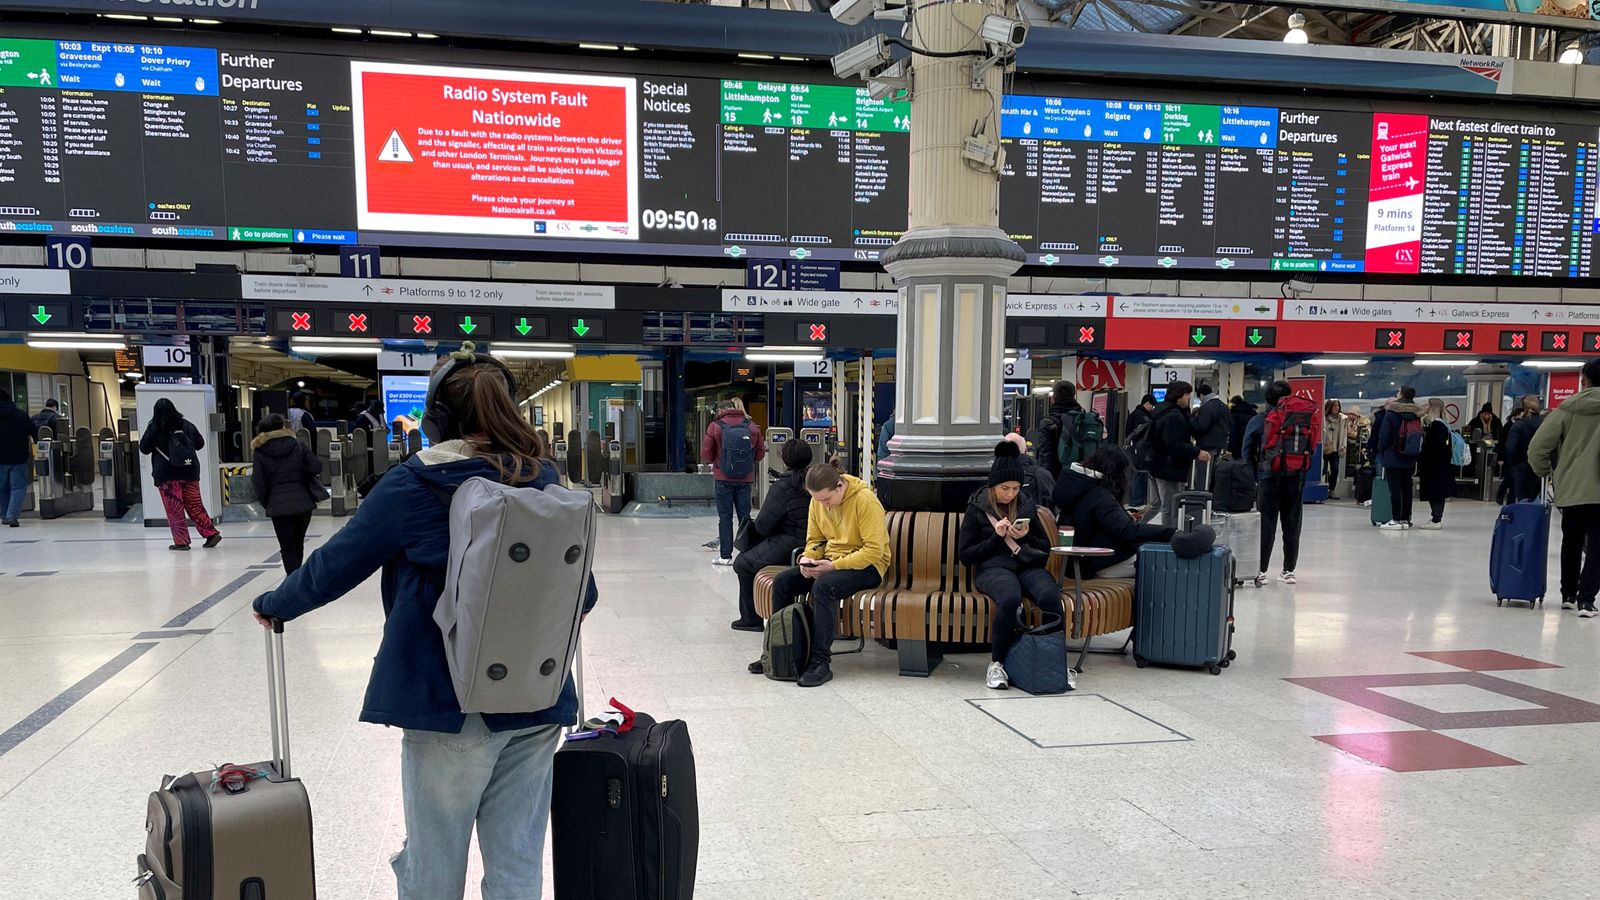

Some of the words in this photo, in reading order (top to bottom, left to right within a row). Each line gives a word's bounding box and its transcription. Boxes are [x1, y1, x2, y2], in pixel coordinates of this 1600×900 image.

[91, 44, 111, 53] Expt
[113, 45, 134, 53] 10:05
[141, 47, 162, 55] 10:10
[60, 53, 102, 61] Gravesend
[141, 57, 164, 65] Dover
[167, 58, 190, 68] Priory
[221, 53, 275, 69] Further
[142, 79, 161, 87] Wait
[222, 74, 303, 91] Departures
[724, 82, 743, 90] 09:46
[758, 83, 787, 93] Delayed
[643, 81, 688, 98] Special
[790, 85, 809, 93] 09:54
[443, 85, 487, 101] Radio
[492, 88, 547, 106] System
[551, 92, 588, 107] Fault
[724, 93, 780, 104] Littlehampton
[791, 94, 803, 102] Ore
[856, 97, 884, 106] Brighton
[643, 98, 691, 113] Notices
[1045, 98, 1062, 106] 10:06
[1129, 103, 1143, 112] Expt
[1044, 107, 1059, 115] West
[472, 110, 561, 128] Nationwide
[724, 113, 736, 122] 15
[791, 116, 803, 125] 18
[1105, 112, 1131, 122] Reigate
[1164, 113, 1188, 122] Dorking
[1223, 118, 1271, 127] Littlehampton
[1280, 112, 1320, 125] Further
[856, 119, 868, 128] 14
[1430, 119, 1454, 131] Next
[1455, 120, 1489, 132] fastest
[1491, 122, 1519, 134] direct
[1520, 124, 1544, 136] train
[1545, 126, 1556, 136] to
[452, 129, 468, 137] fault
[470, 130, 487, 138] with
[489, 131, 501, 139] the
[503, 132, 522, 140] radio
[524, 134, 552, 143] systems
[554, 135, 585, 143] between
[587, 136, 599, 144] the
[601, 137, 622, 145] driver
[1164, 133, 1174, 142] 11
[1279, 130, 1338, 144] Departures
[434, 139, 446, 147] the
[448, 140, 481, 149] signaller,
[483, 142, 515, 151] affecting
[527, 144, 544, 152] train
[546, 145, 574, 153] services
[576, 146, 593, 154] from
[595, 147, 623, 156] Victoria
[1380, 144, 1398, 153] Your
[1400, 140, 1417, 150] next
[437, 150, 458, 158] other
[459, 151, 487, 159] London
[489, 152, 526, 161] Terminals.
[530, 155, 562, 164] Journeys
[563, 157, 578, 165] may
[580, 157, 596, 165] take
[597, 158, 620, 167] longer
[1381, 150, 1412, 162] Gatwick
[452, 162, 474, 170] usual,
[492, 164, 521, 172] services
[548, 166, 574, 175] subject
[585, 168, 610, 177] delays,
[1381, 161, 1413, 173] Express
[471, 174, 510, 182] alterations
[512, 175, 526, 183] and
[527, 176, 574, 185] cancellations
[1382, 171, 1400, 182] train
[472, 194, 495, 202] Please
[497, 195, 517, 203] check
[519, 198, 536, 206] your
[537, 197, 565, 206] journey
[492, 206, 556, 215] Nationalrail.co.uk
[1378, 208, 1384, 217] 9
[1387, 208, 1413, 219] mins
[642, 209, 699, 230] 09:50
[701, 218, 717, 230] 18
[0, 222, 53, 232] utheastern
[71, 223, 134, 233] southeastern
[152, 226, 214, 237] southeastern
[1374, 224, 1405, 232] Platform
[1407, 224, 1415, 232] 14
[262, 231, 288, 240] platform
[51, 242, 87, 269] 10
[350, 253, 372, 278] 11
[753, 264, 778, 288] 12
[0, 277, 20, 287] only
[399, 287, 445, 298] Platforms
[447, 287, 454, 298] 9
[457, 289, 467, 299] to
[470, 289, 481, 299] 12
[483, 289, 504, 301] only
[797, 297, 819, 307] Wide
[821, 298, 840, 309] gate
[1007, 301, 1023, 310] wick
[1025, 302, 1058, 313] Express
[1351, 307, 1371, 315] Wide
[1372, 308, 1392, 317] gates
[1451, 309, 1480, 318] Gatwick
[1482, 310, 1510, 320] Express
[164, 348, 185, 363] 10
[400, 352, 414, 367] 11
[812, 361, 828, 374] 12
[1004, 364, 1014, 376] 3
[1165, 371, 1178, 381] 13
